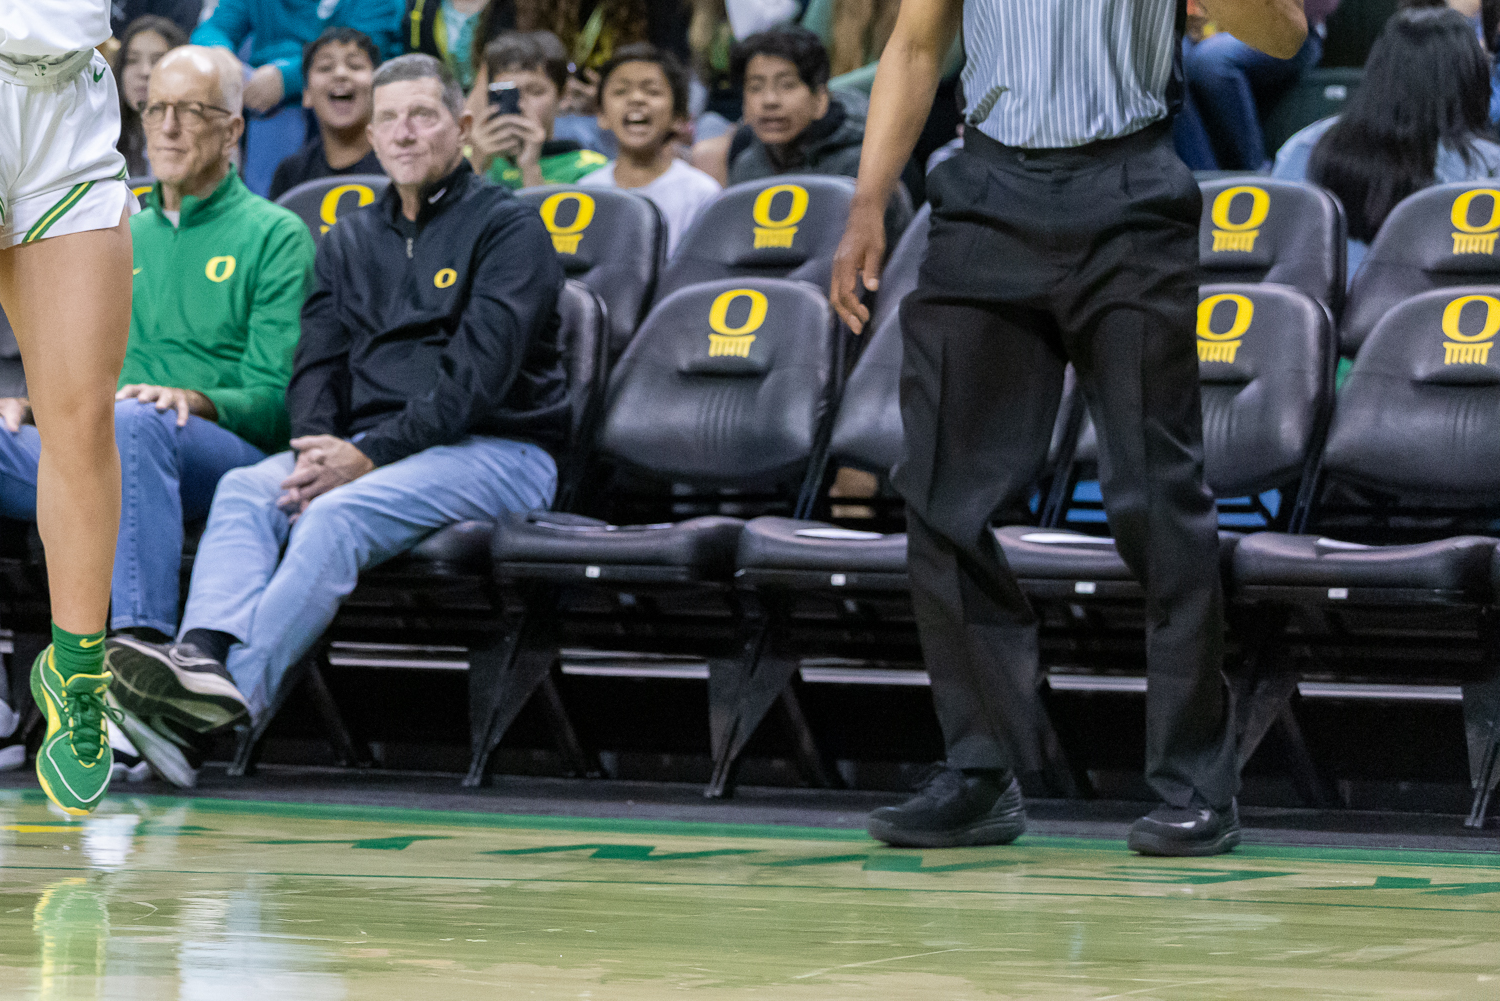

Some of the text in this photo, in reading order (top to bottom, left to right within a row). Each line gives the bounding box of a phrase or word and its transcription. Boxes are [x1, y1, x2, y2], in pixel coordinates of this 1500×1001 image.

[540, 192, 595, 233] O
[753, 185, 809, 227] O
[1212, 186, 1270, 229] O
[1451, 189, 1500, 232] O
[205, 255, 237, 283] O
[709, 289, 768, 335] O
[1196, 294, 1254, 340] O
[1442, 295, 1500, 342] O
